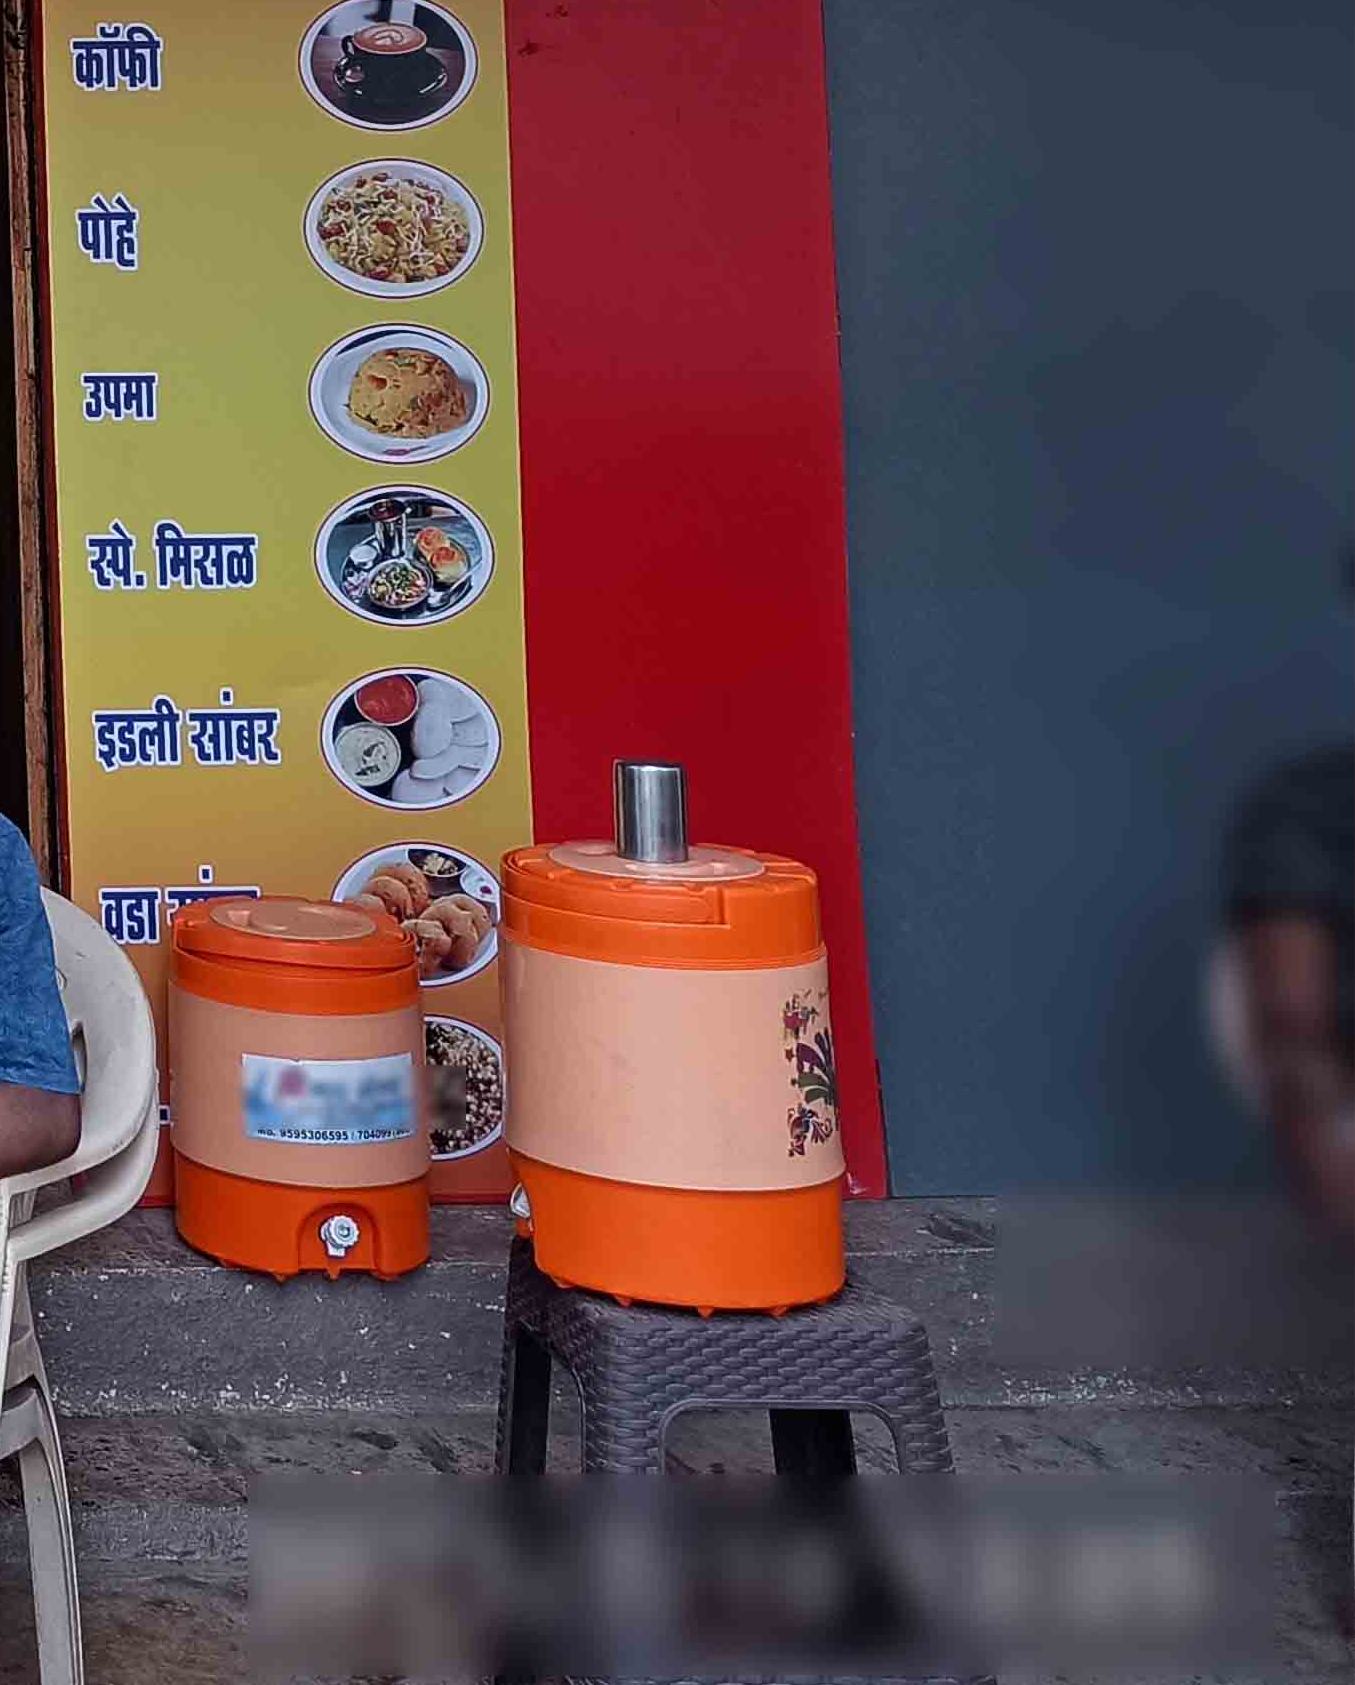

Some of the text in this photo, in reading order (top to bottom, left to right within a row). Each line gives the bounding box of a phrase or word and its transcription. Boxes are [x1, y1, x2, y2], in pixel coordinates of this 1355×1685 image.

[70, 24, 161, 90] कॉफी
[76, 193, 138, 270] पोहे
[81, 372, 157, 420] उपमा
[86, 519, 258, 589] स्पे. मिसळ
[92, 688, 281, 772] इडली सांबर
[100, 887, 161, 944] वडा
